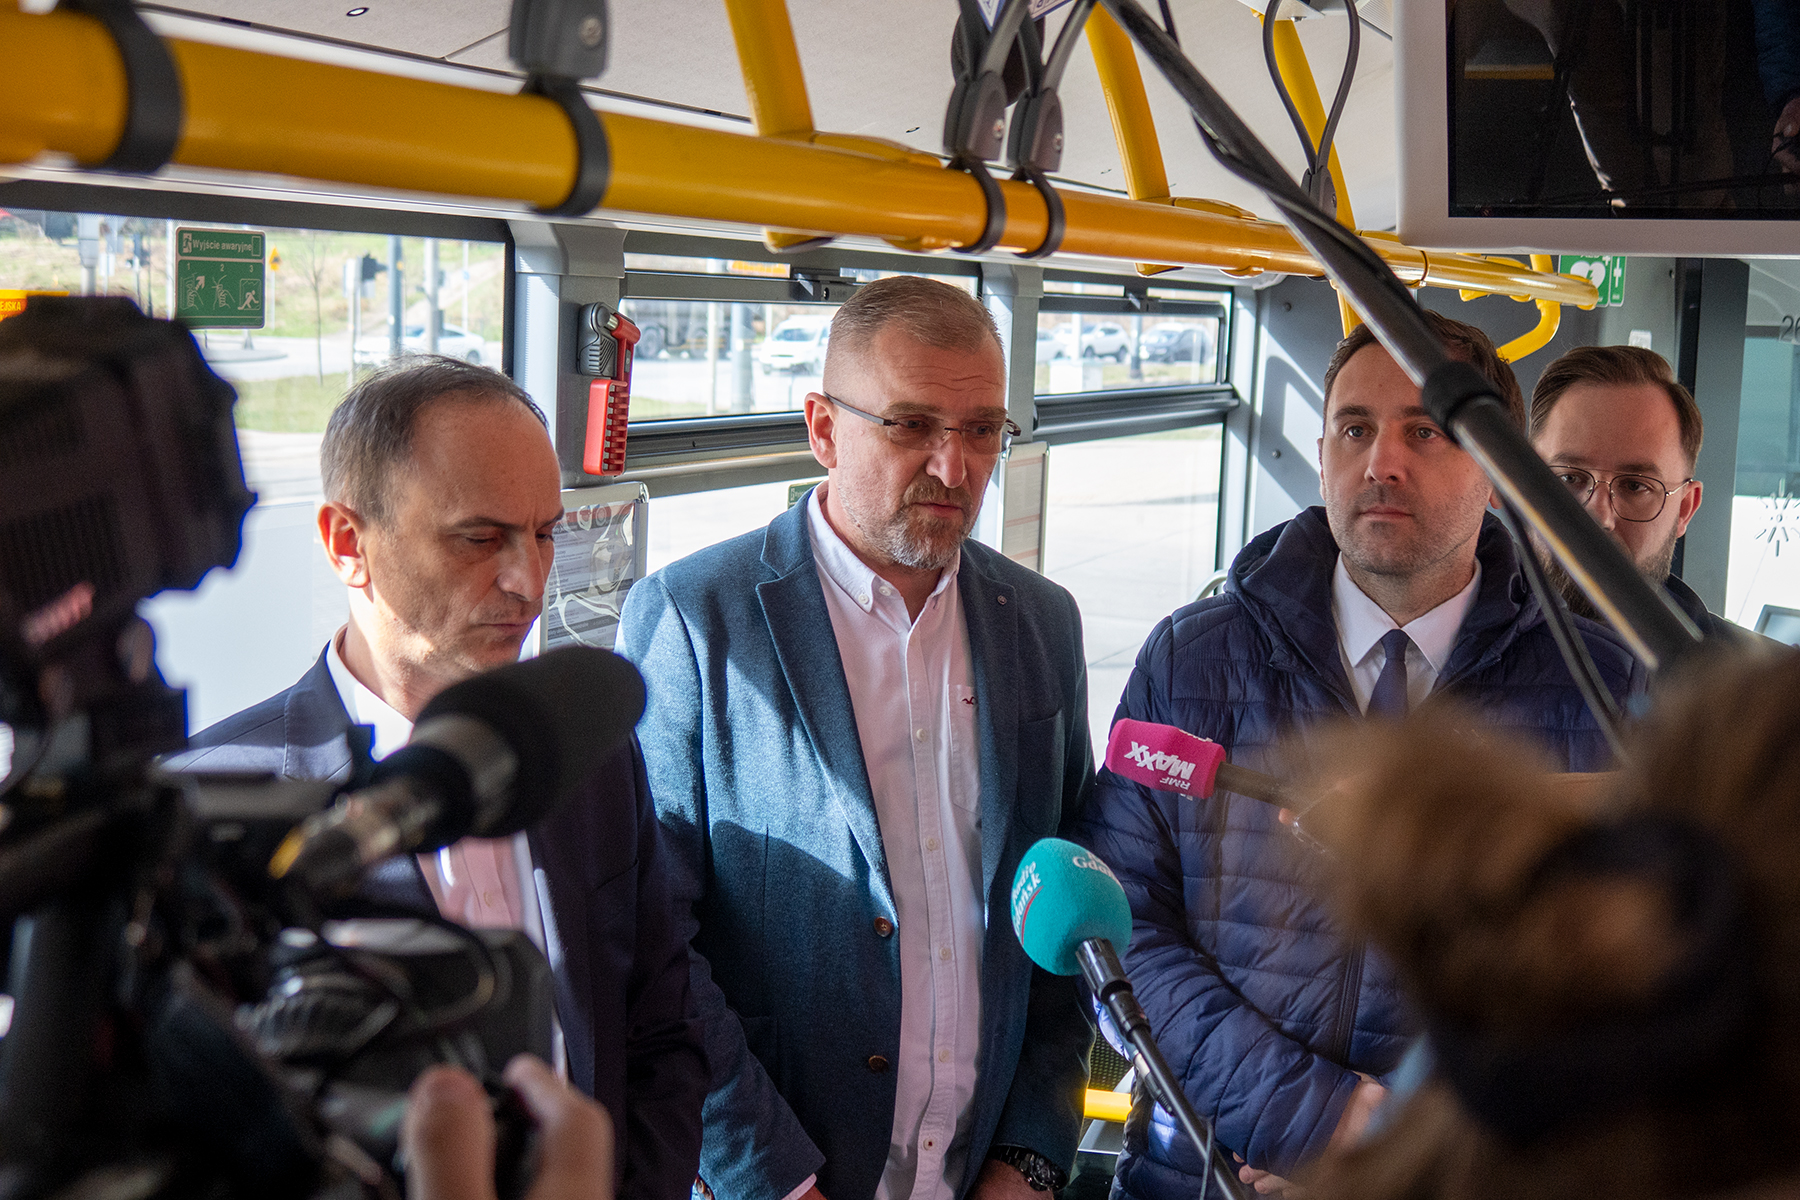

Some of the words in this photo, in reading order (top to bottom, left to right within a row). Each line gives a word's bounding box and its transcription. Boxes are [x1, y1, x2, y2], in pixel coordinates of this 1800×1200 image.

[193, 239, 220, 251] Wyjście
[221, 241, 253, 253] awaryjne
[220, 264, 224, 272] 2
[1124, 741, 1196, 780] MAXX
[1160, 776, 1191, 790] RMF
